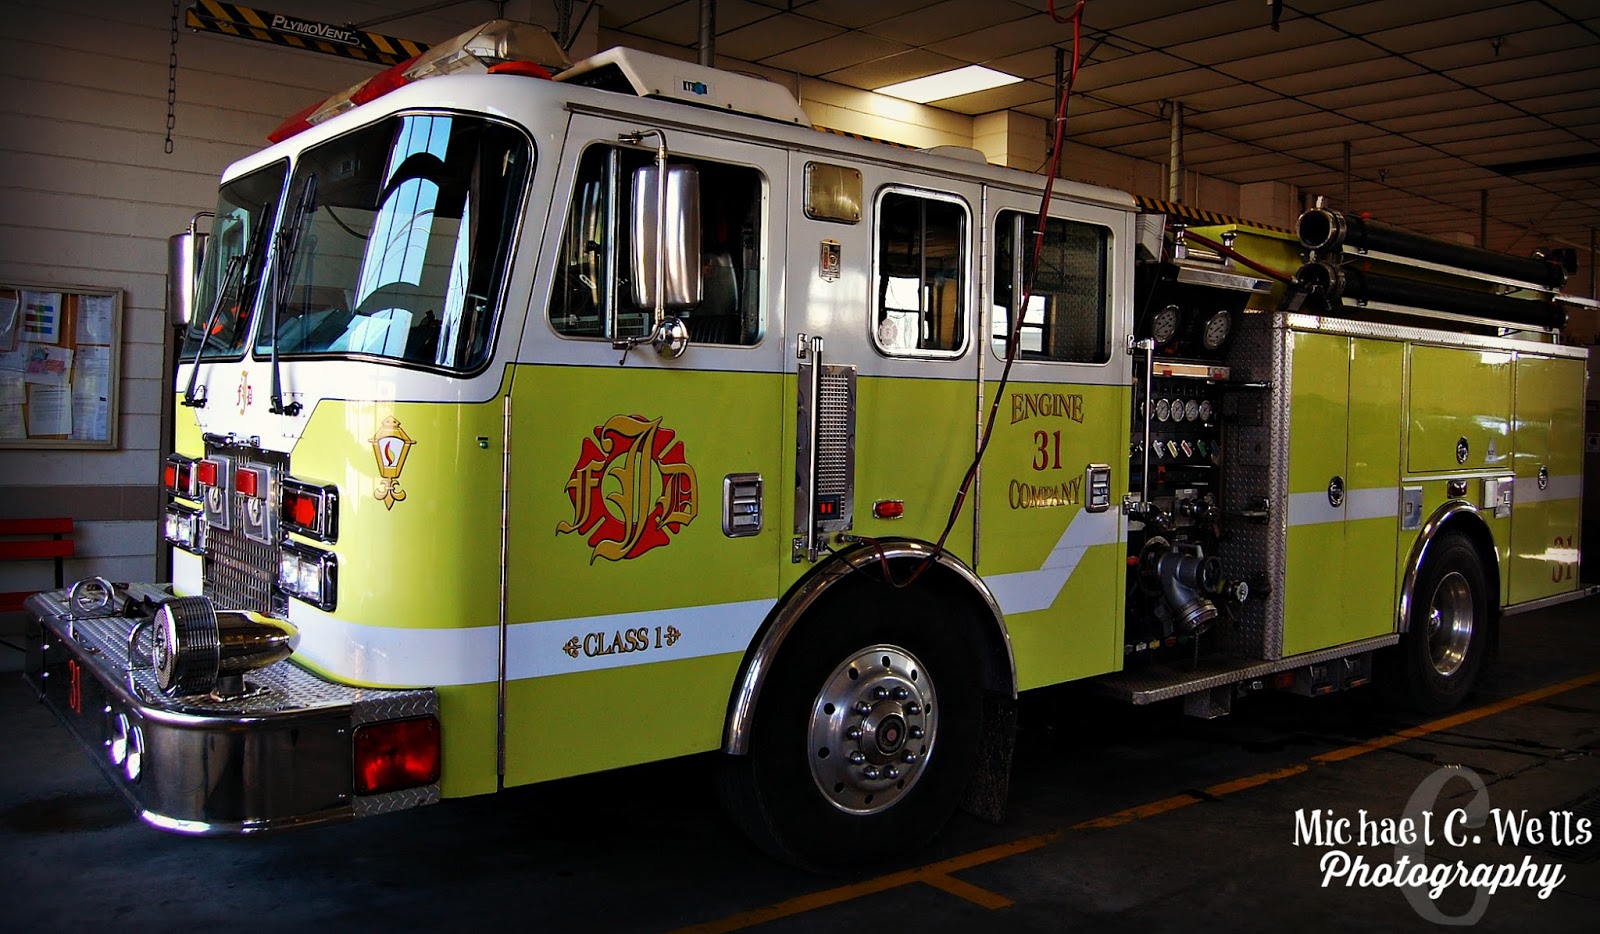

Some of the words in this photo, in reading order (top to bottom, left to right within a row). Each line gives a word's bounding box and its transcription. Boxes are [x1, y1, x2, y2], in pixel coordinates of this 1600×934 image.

[1010, 393, 1084, 425] ENGINE
[1032, 429, 1062, 471] 31
[1008, 474, 1083, 510] COMPANY
[583, 627, 649, 657] CLASS
[654, 626, 662, 649] 1
[68, 659, 81, 715] 31
